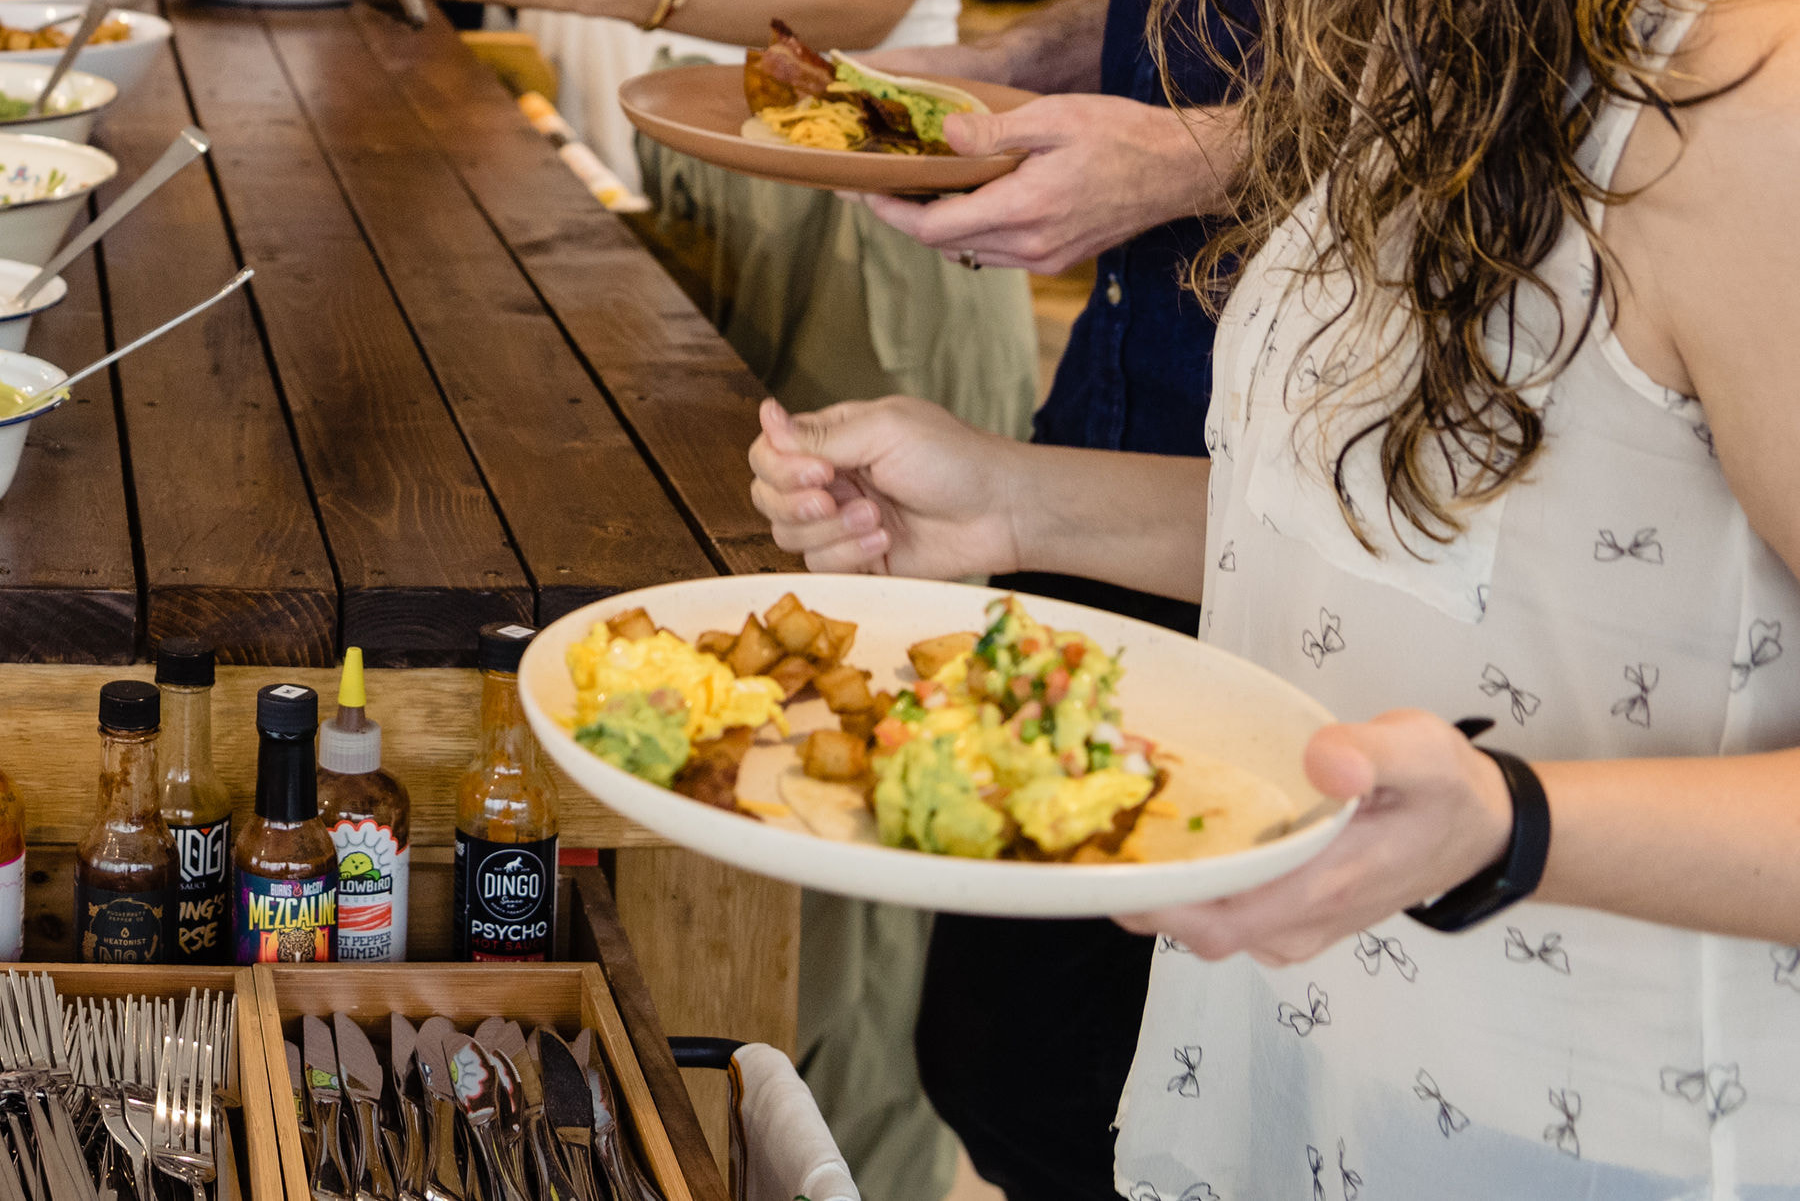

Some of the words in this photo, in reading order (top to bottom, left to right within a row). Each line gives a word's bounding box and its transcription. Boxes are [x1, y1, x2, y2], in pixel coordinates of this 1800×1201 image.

[270, 883, 292, 897] BURNS
[484, 873, 539, 898] DINGO
[179, 894, 226, 922] ING'S
[249, 887, 337, 930] MEZCALINE
[352, 932, 392, 947] PEPPER
[471, 919, 548, 941] PSYCHO
[103, 937, 148, 947] HEATONIST
[341, 943, 392, 960] DIMENT
